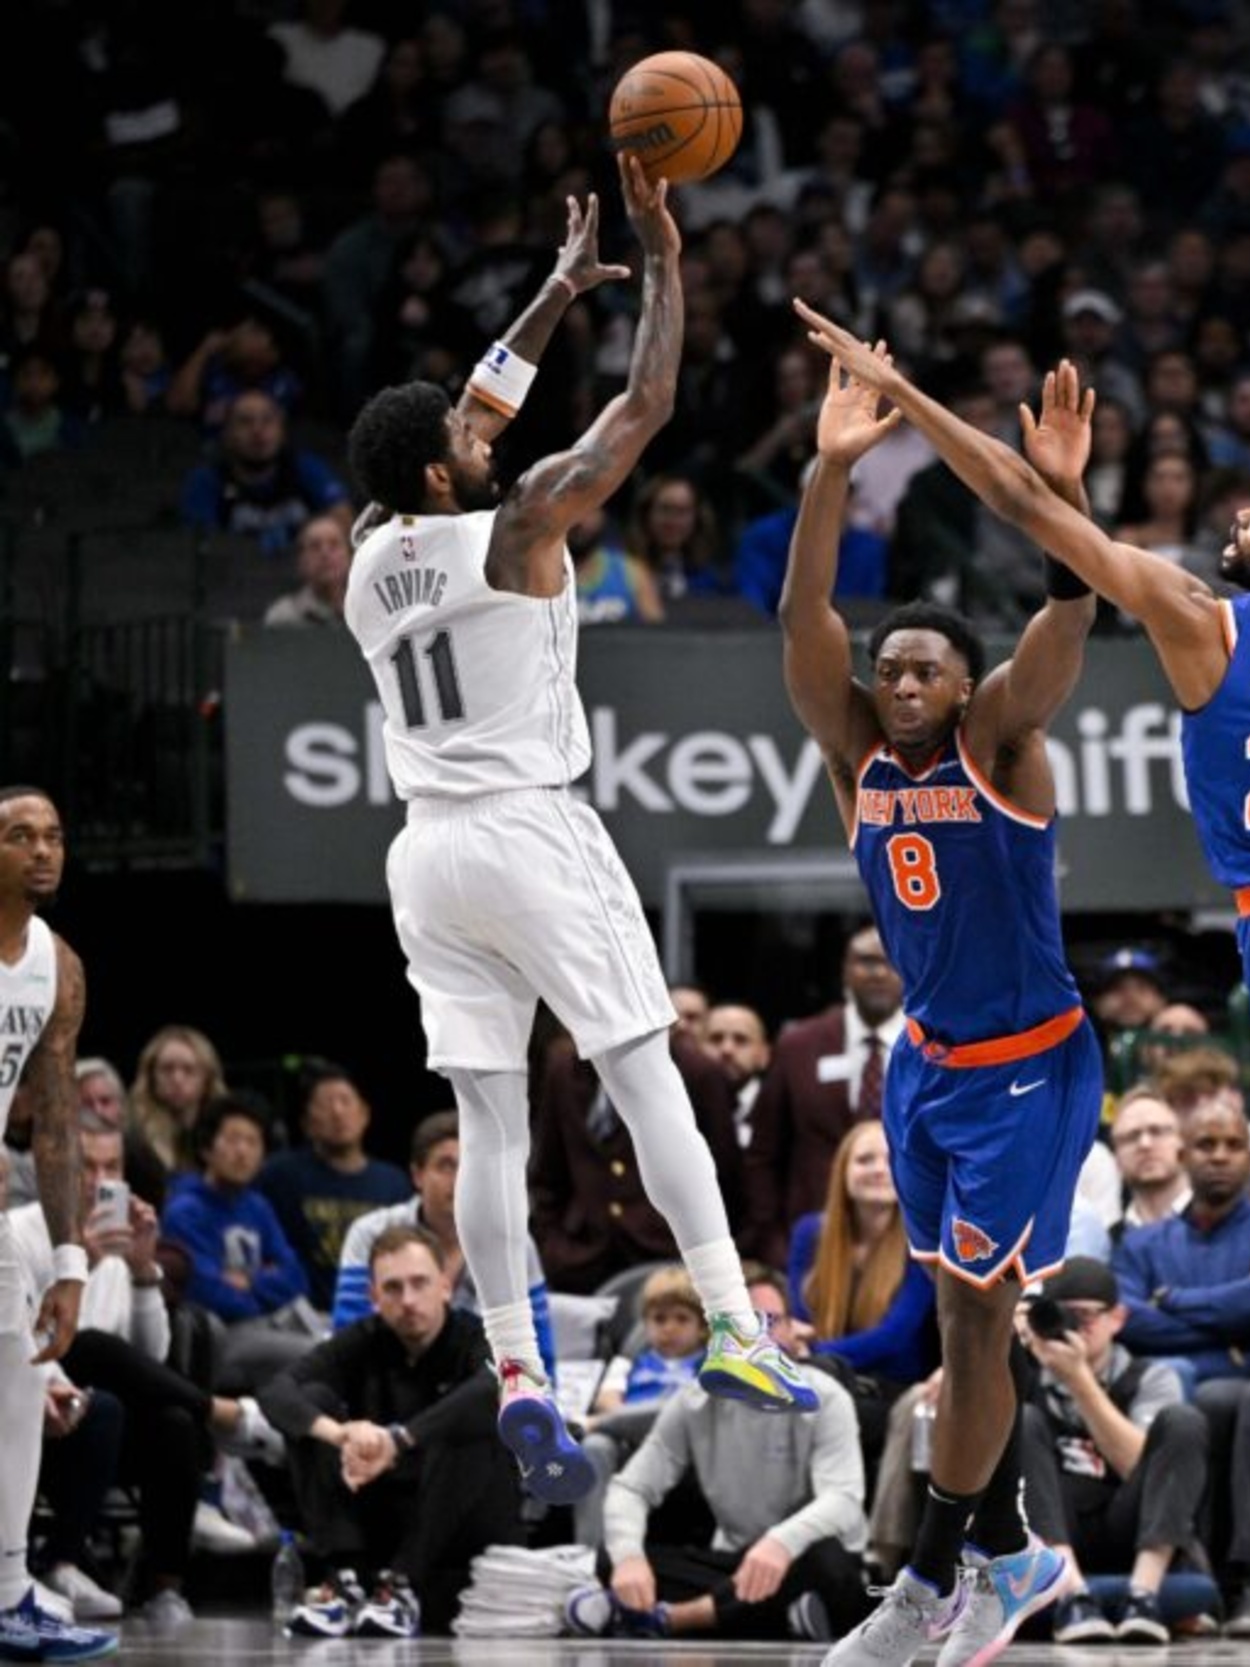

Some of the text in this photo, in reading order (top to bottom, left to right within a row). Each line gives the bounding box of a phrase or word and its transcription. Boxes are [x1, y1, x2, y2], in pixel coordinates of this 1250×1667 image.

[373, 568, 447, 615] IRVING
[390, 626, 466, 731] 11
[898, 785, 983, 824] YORK
[886, 831, 942, 911] 8
